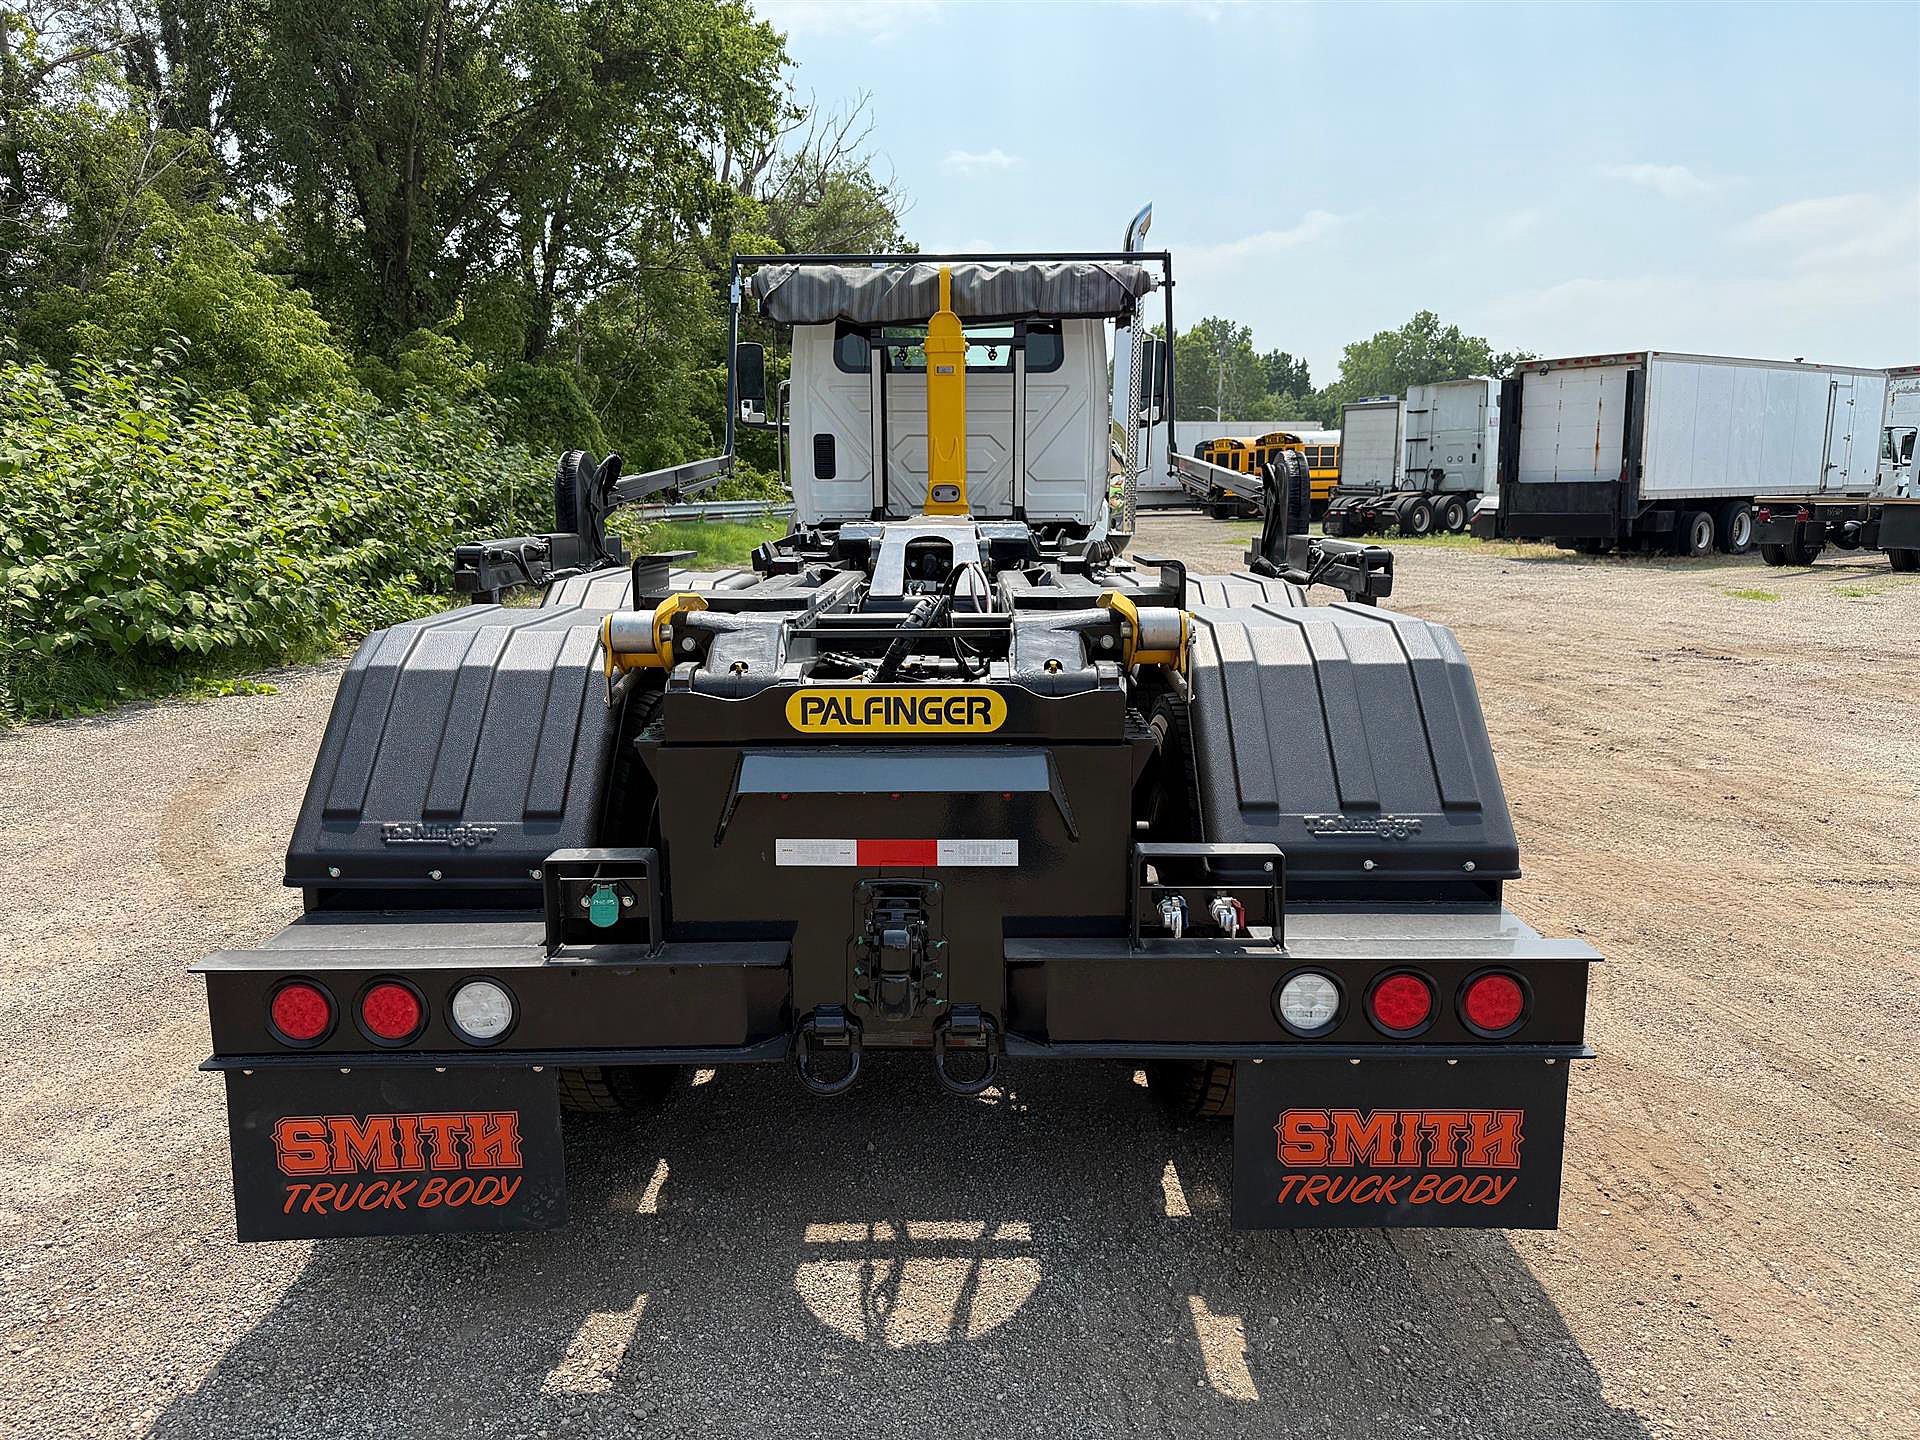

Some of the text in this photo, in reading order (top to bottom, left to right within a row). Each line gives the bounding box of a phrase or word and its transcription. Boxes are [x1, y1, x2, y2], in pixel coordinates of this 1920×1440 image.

[800, 696, 992, 726] PALFINGER
[270, 1110, 524, 1177] SMITH
[1273, 1108, 1526, 1169] SMITH
[283, 1175, 523, 1215] TRUCK BODY
[1277, 1174, 1518, 1206] TRUCK BODY
